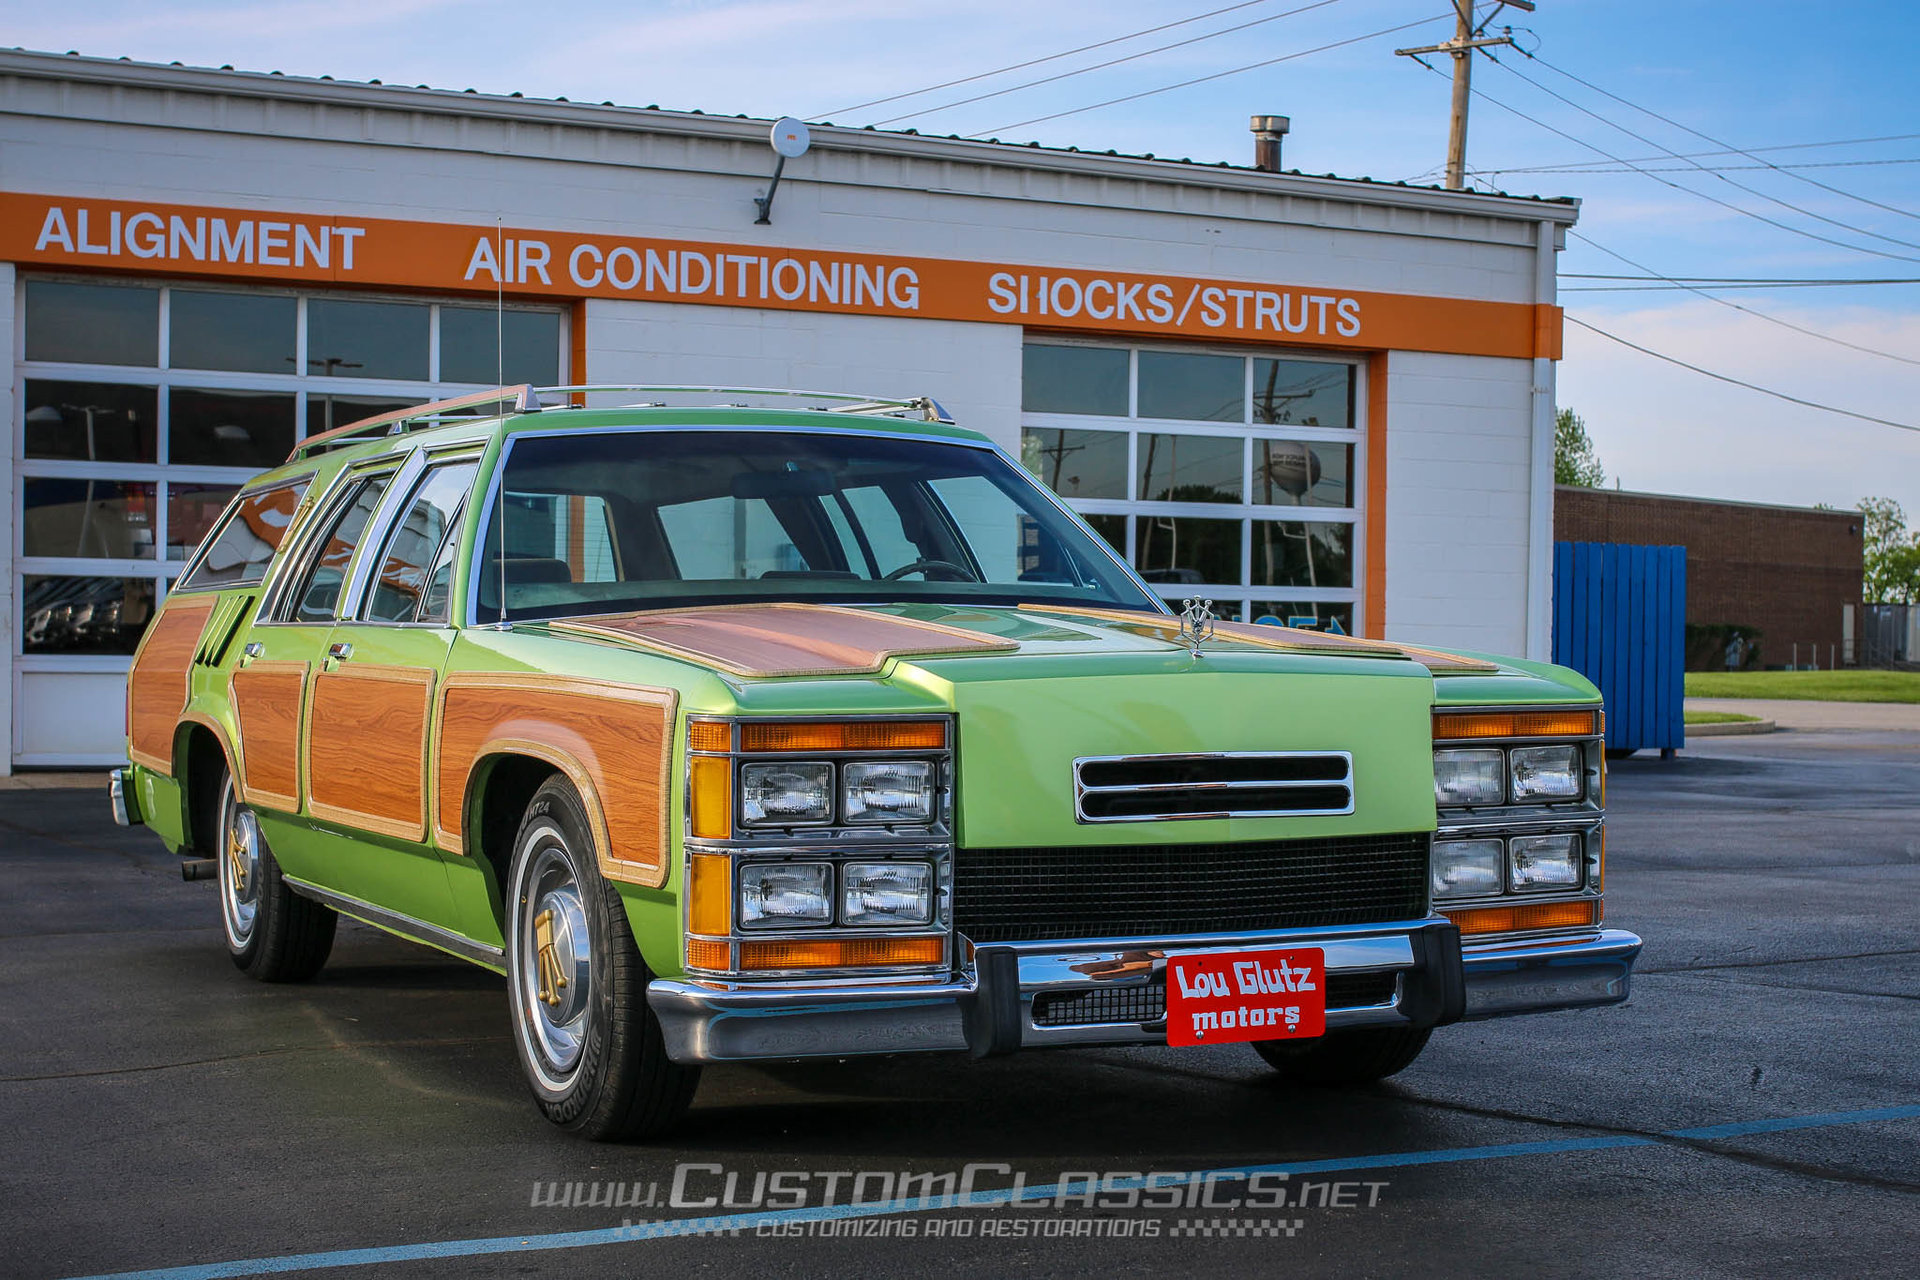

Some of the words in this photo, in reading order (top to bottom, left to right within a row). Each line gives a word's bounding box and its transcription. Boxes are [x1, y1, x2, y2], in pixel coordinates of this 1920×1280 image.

[34, 206, 366, 270] ALIGNMENT
[464, 236, 552, 286] AIR
[568, 243, 919, 310] CONDITIONING
[1175, 965, 1230, 999] Lou
[1233, 959, 1316, 995] Glutz
[1192, 1005, 1300, 1031] motors
